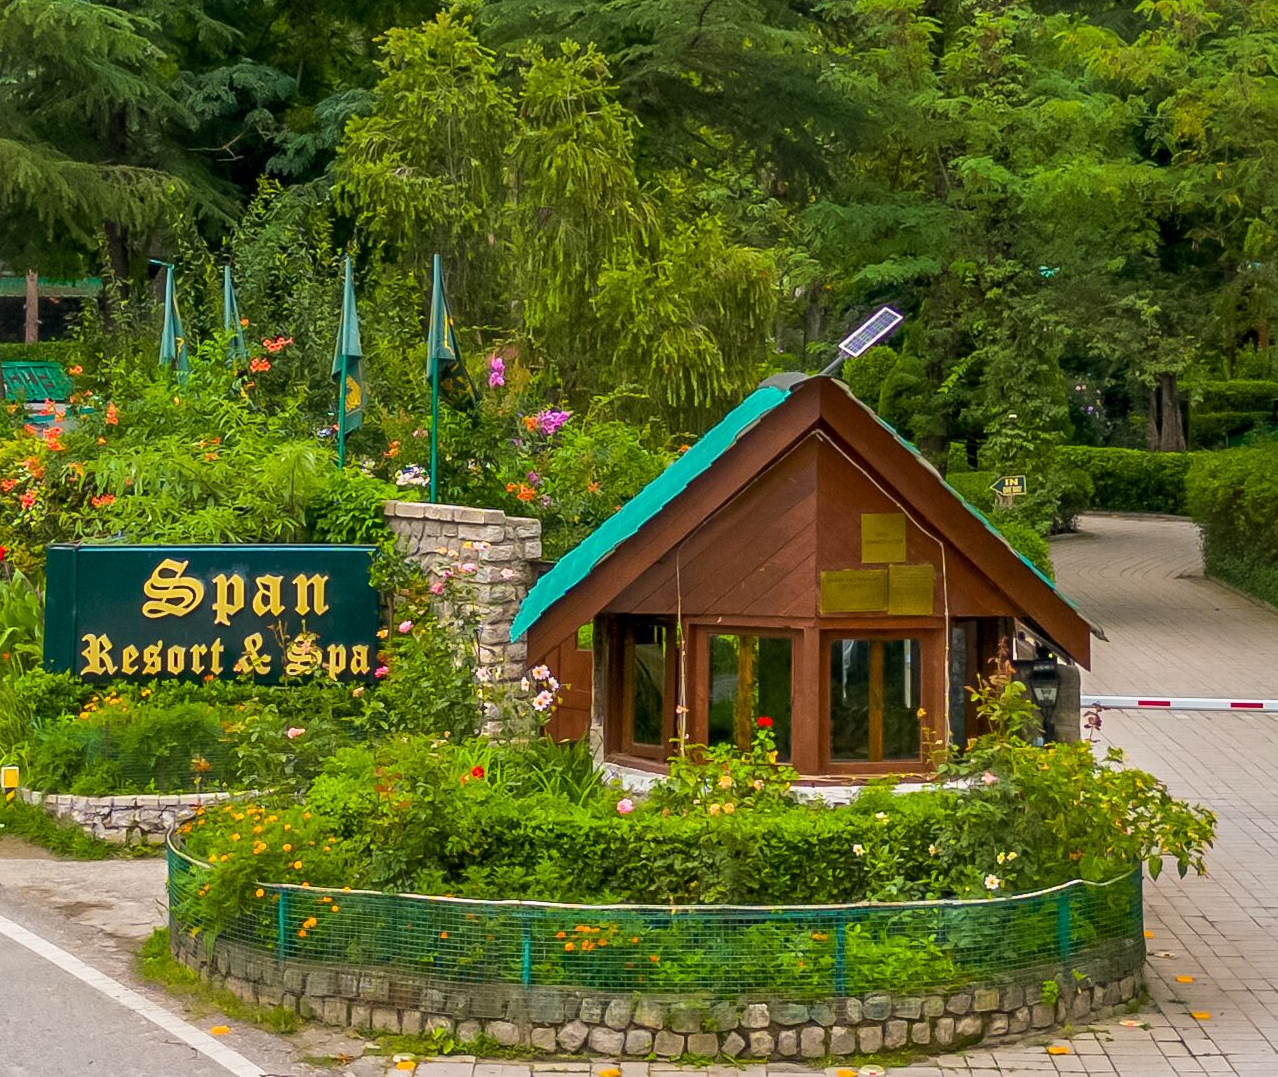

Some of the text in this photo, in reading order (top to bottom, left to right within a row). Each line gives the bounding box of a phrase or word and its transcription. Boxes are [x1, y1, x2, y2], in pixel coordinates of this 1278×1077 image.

[1004, 478, 1019, 486] IN
[141, 557, 330, 626] Span
[80, 631, 371, 681] Resort & Spa
